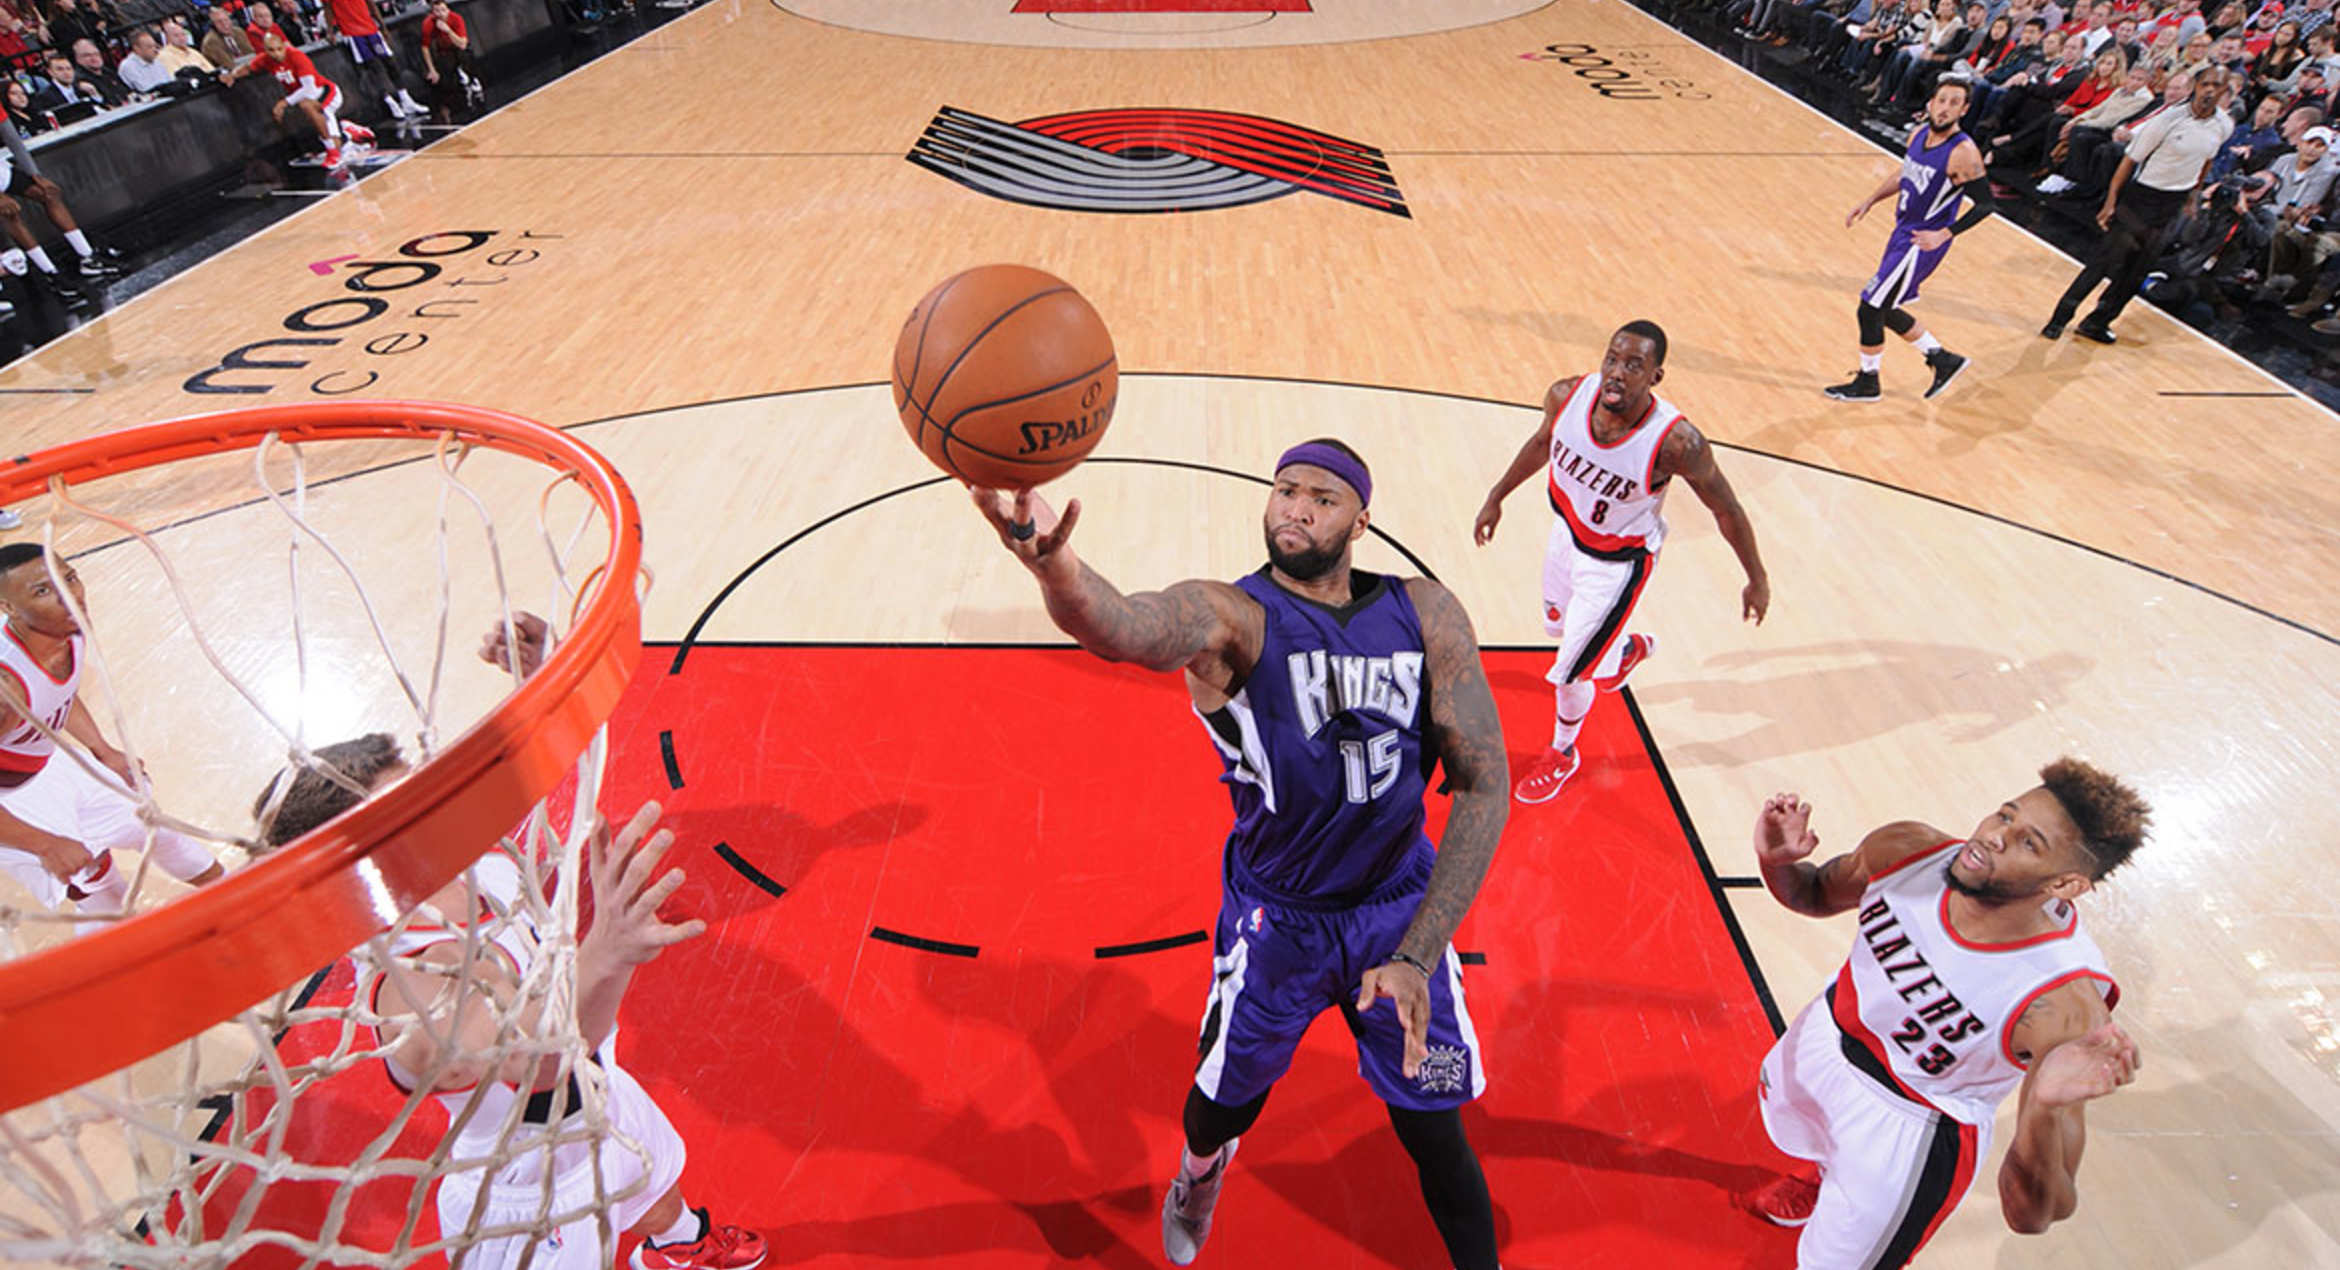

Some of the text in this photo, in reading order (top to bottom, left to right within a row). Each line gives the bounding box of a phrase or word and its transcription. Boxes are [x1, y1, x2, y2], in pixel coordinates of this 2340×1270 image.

[1520, 44, 1662, 100] moda
[1606, 46, 1713, 100] cente
[183, 230, 499, 395] moda
[311, 230, 563, 395] center
[1018, 402, 1113, 455] SPALD
[1553, 439, 1638, 500] BLAZERS
[1591, 498, 1609, 526] 8
[1288, 649, 1425, 741] KINGS
[1339, 728, 1402, 804] 15
[1859, 895, 1985, 1043] BLAZERS
[1890, 1016, 1958, 1076] 23
